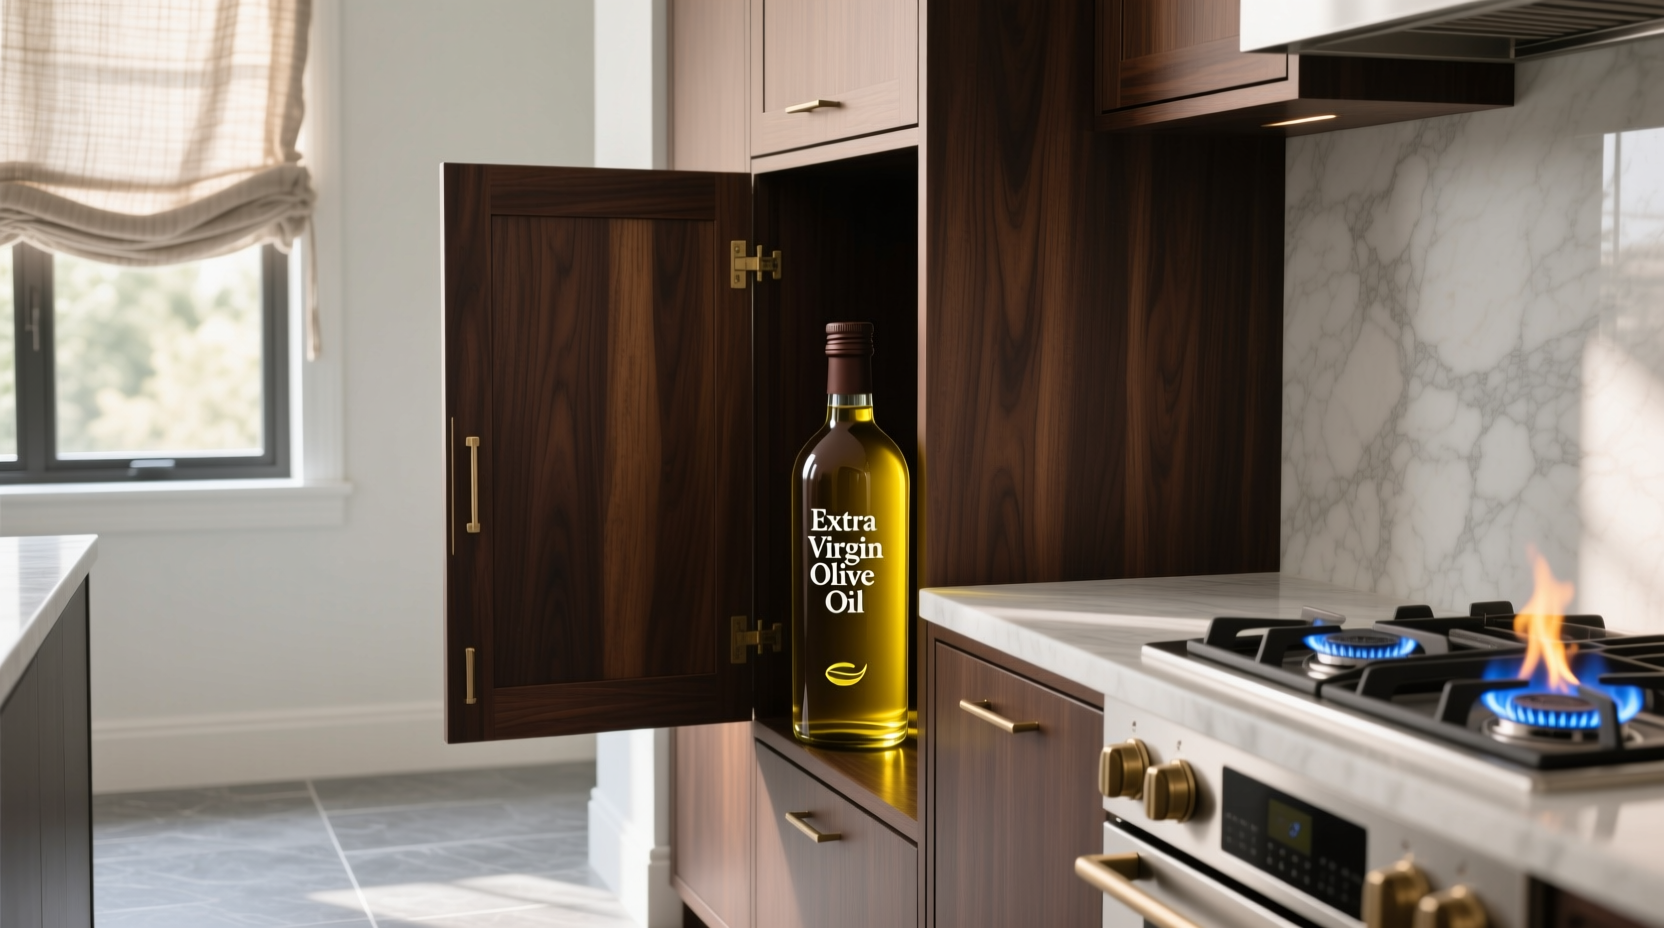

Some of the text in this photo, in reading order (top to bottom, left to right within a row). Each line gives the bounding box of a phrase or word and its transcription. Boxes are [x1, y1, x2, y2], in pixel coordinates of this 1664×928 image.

[810, 508, 876, 532] Extra
[807, 535, 884, 566] Virgin
[810, 562, 875, 586] Olive
[825, 589, 864, 614] Oil
